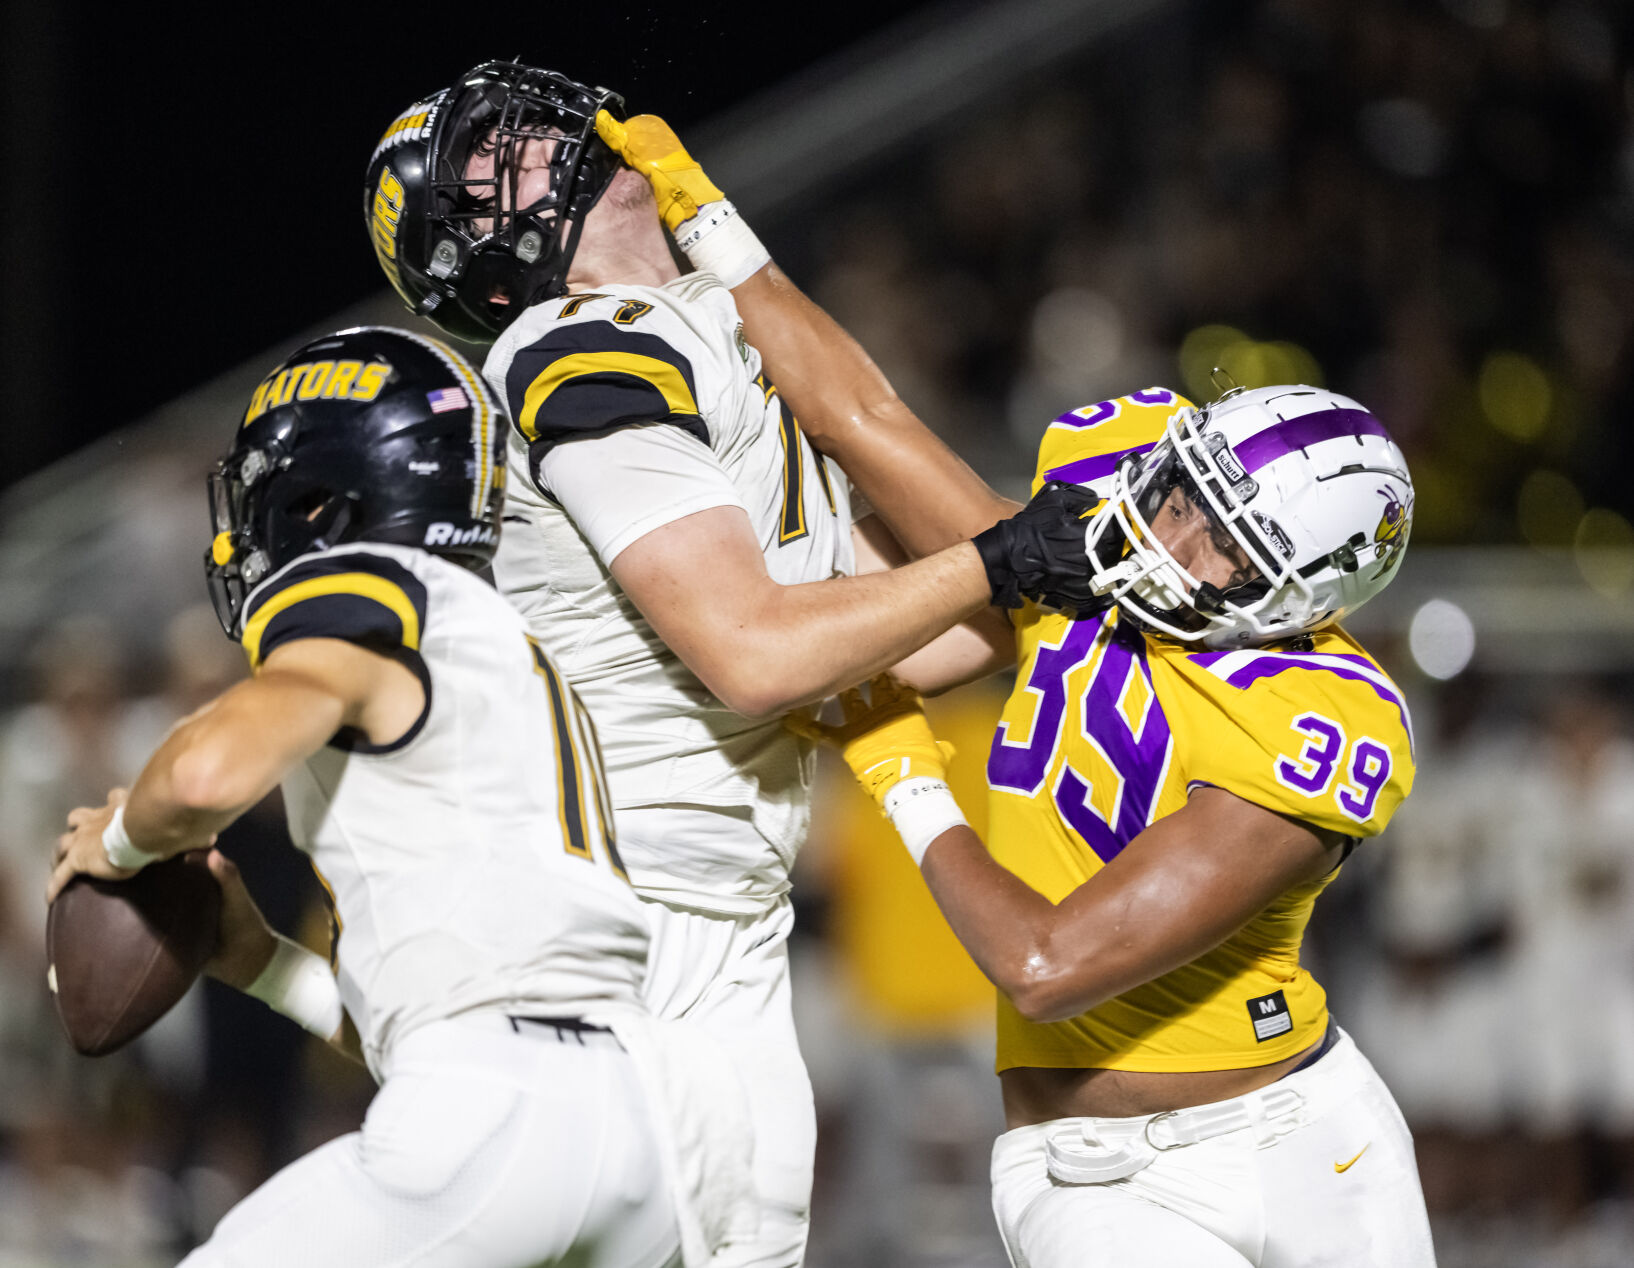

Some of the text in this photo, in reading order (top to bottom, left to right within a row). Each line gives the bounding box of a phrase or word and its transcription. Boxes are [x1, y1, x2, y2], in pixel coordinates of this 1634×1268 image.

[556, 293, 656, 325] 77
[1217, 454, 1240, 482] schutt
[986, 605, 1174, 865] 39
[1273, 711, 1393, 824] 39
[1258, 998, 1277, 1015] M
